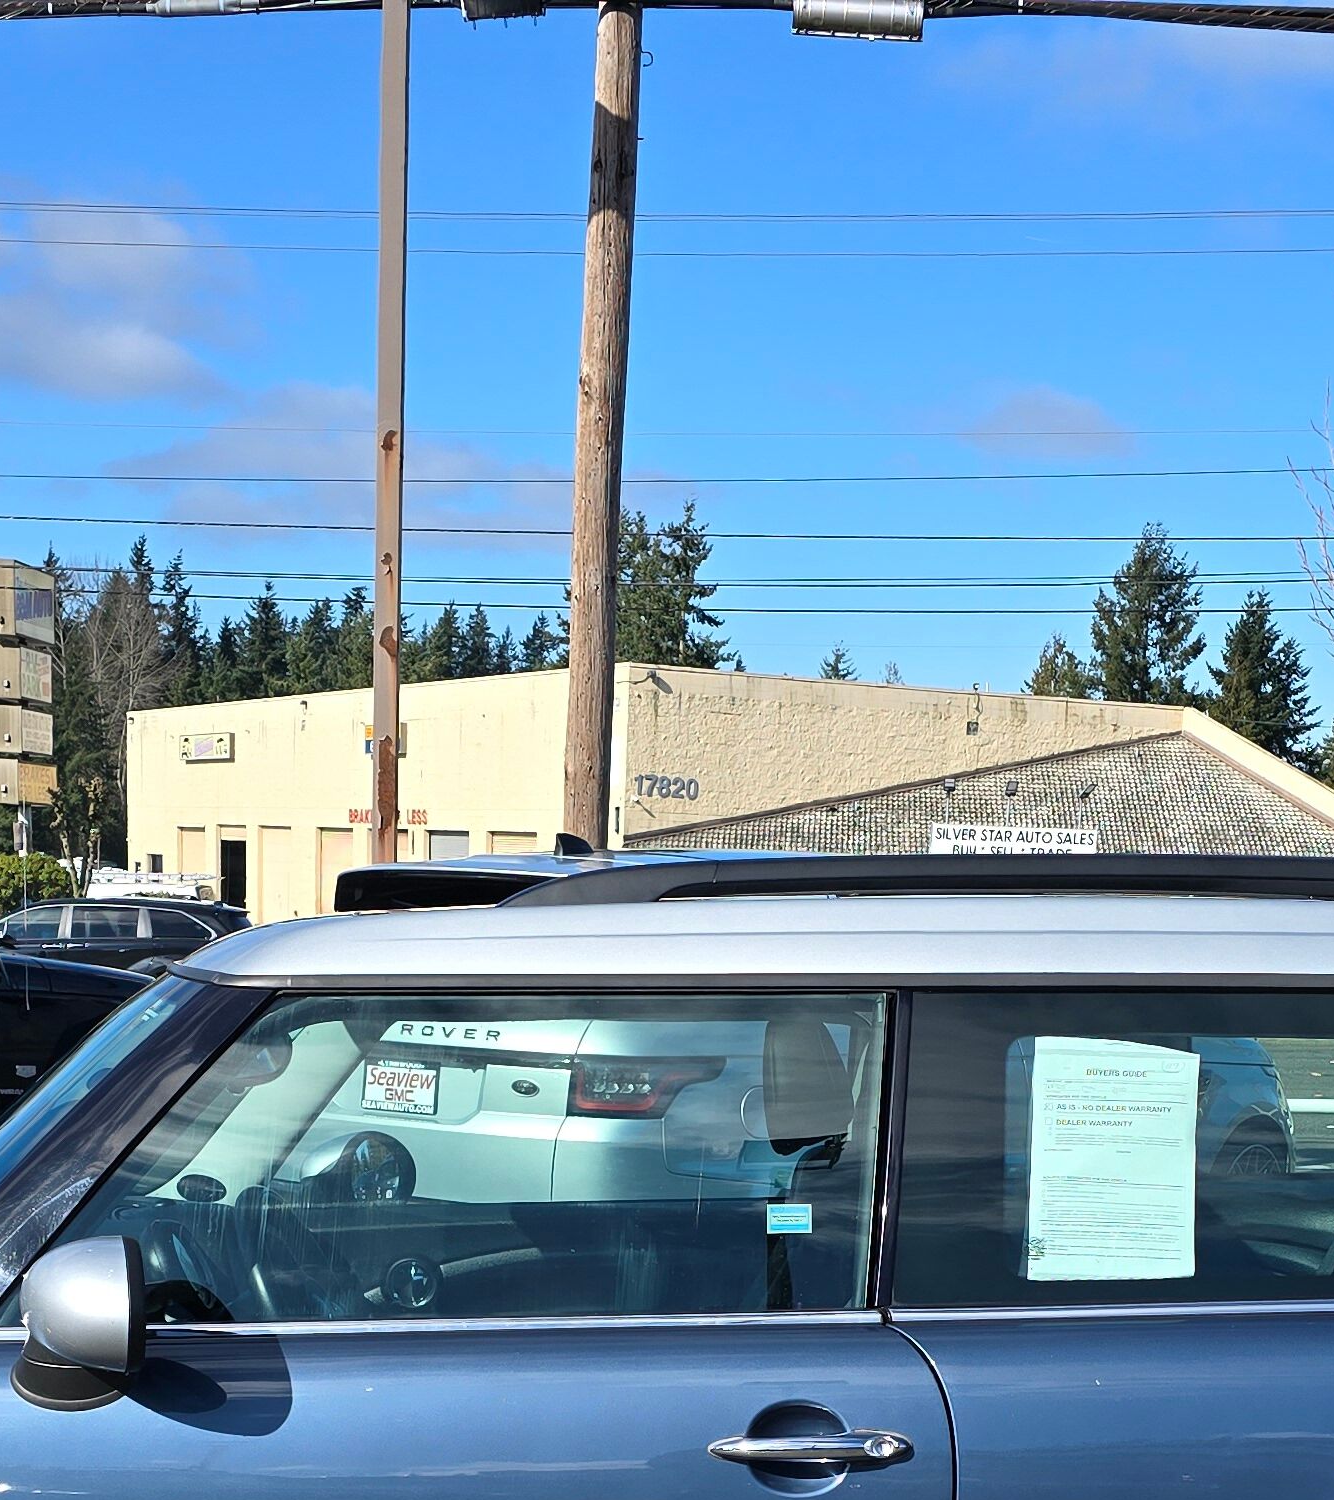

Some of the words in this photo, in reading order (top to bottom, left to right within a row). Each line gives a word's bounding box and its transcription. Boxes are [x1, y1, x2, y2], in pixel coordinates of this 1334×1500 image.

[635, 774, 699, 801] 17820
[349, 808, 373, 823] BRAK
[407, 808, 428, 825] LESS
[935, 827, 976, 841] SILVER
[980, 829, 1013, 843] STAR
[1016, 831, 1053, 844] AUTO
[1056, 832, 1094, 846] SALES
[401, 1023, 501, 1041] ROVER
[367, 1067, 436, 1090] Seaview
[1122, 1070, 1147, 1078] GUIDE
[385, 1088, 415, 1102] GMC
[361, 1100, 434, 1115] SEAVIEWAUTO.COM
[1128, 1105, 1172, 1113] WARRANTY
[1088, 1119, 1133, 1127] WARRANTY
